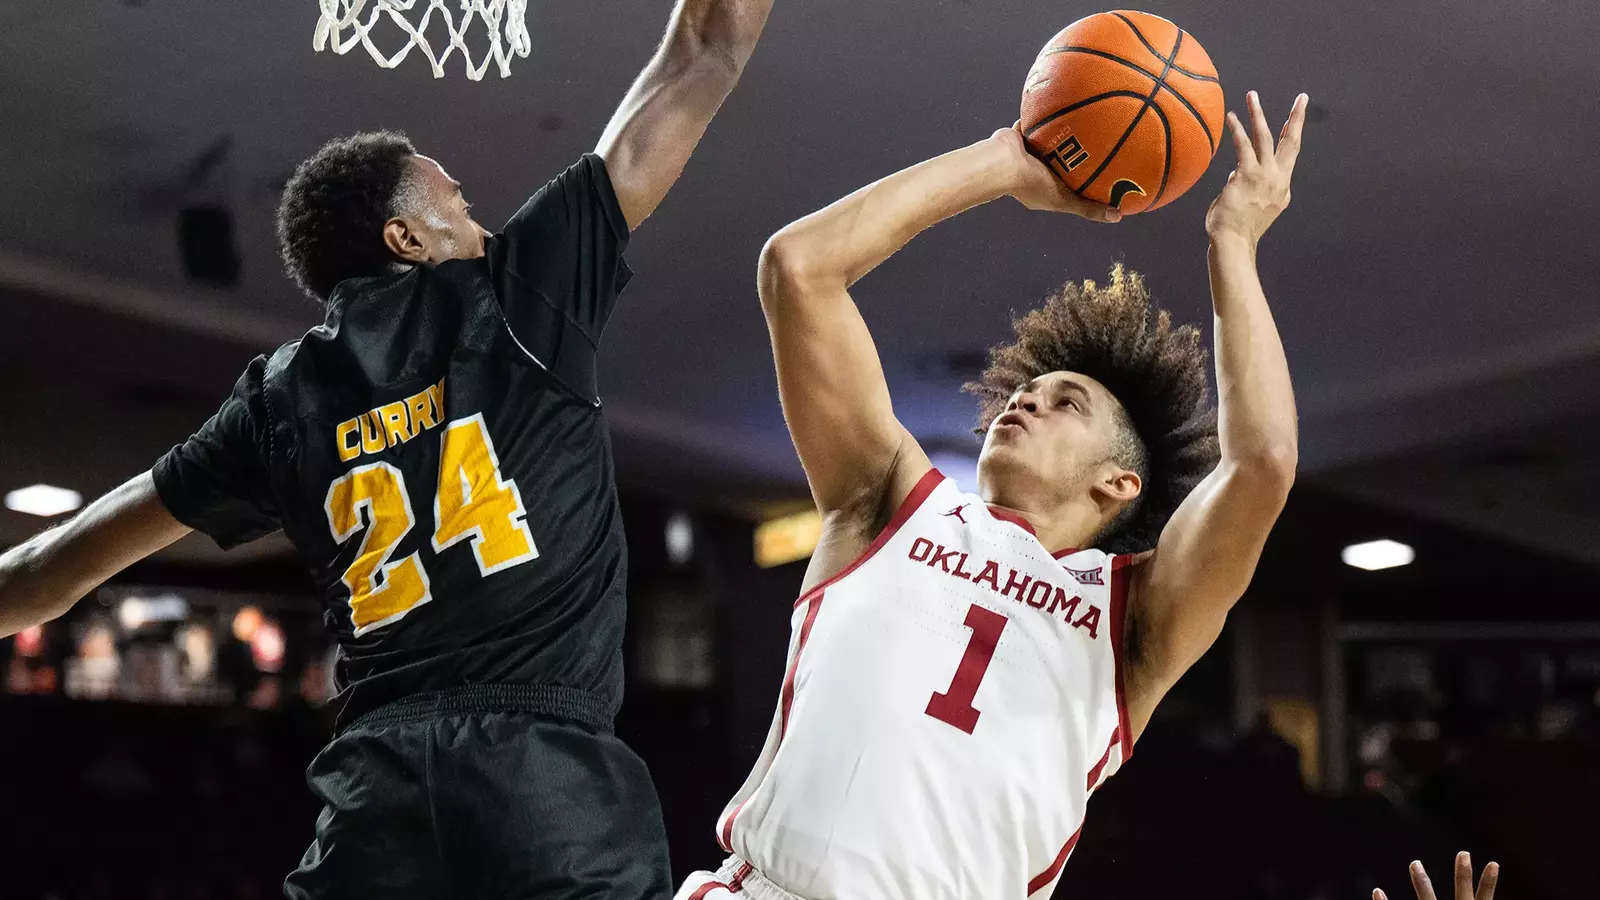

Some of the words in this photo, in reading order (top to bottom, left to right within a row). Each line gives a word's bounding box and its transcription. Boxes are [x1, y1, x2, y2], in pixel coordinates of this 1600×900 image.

[336, 376, 446, 463] CURRY
[323, 411, 540, 639] 24
[907, 537, 1102, 640] OKLAHOMA
[924, 603, 1009, 735] 1
